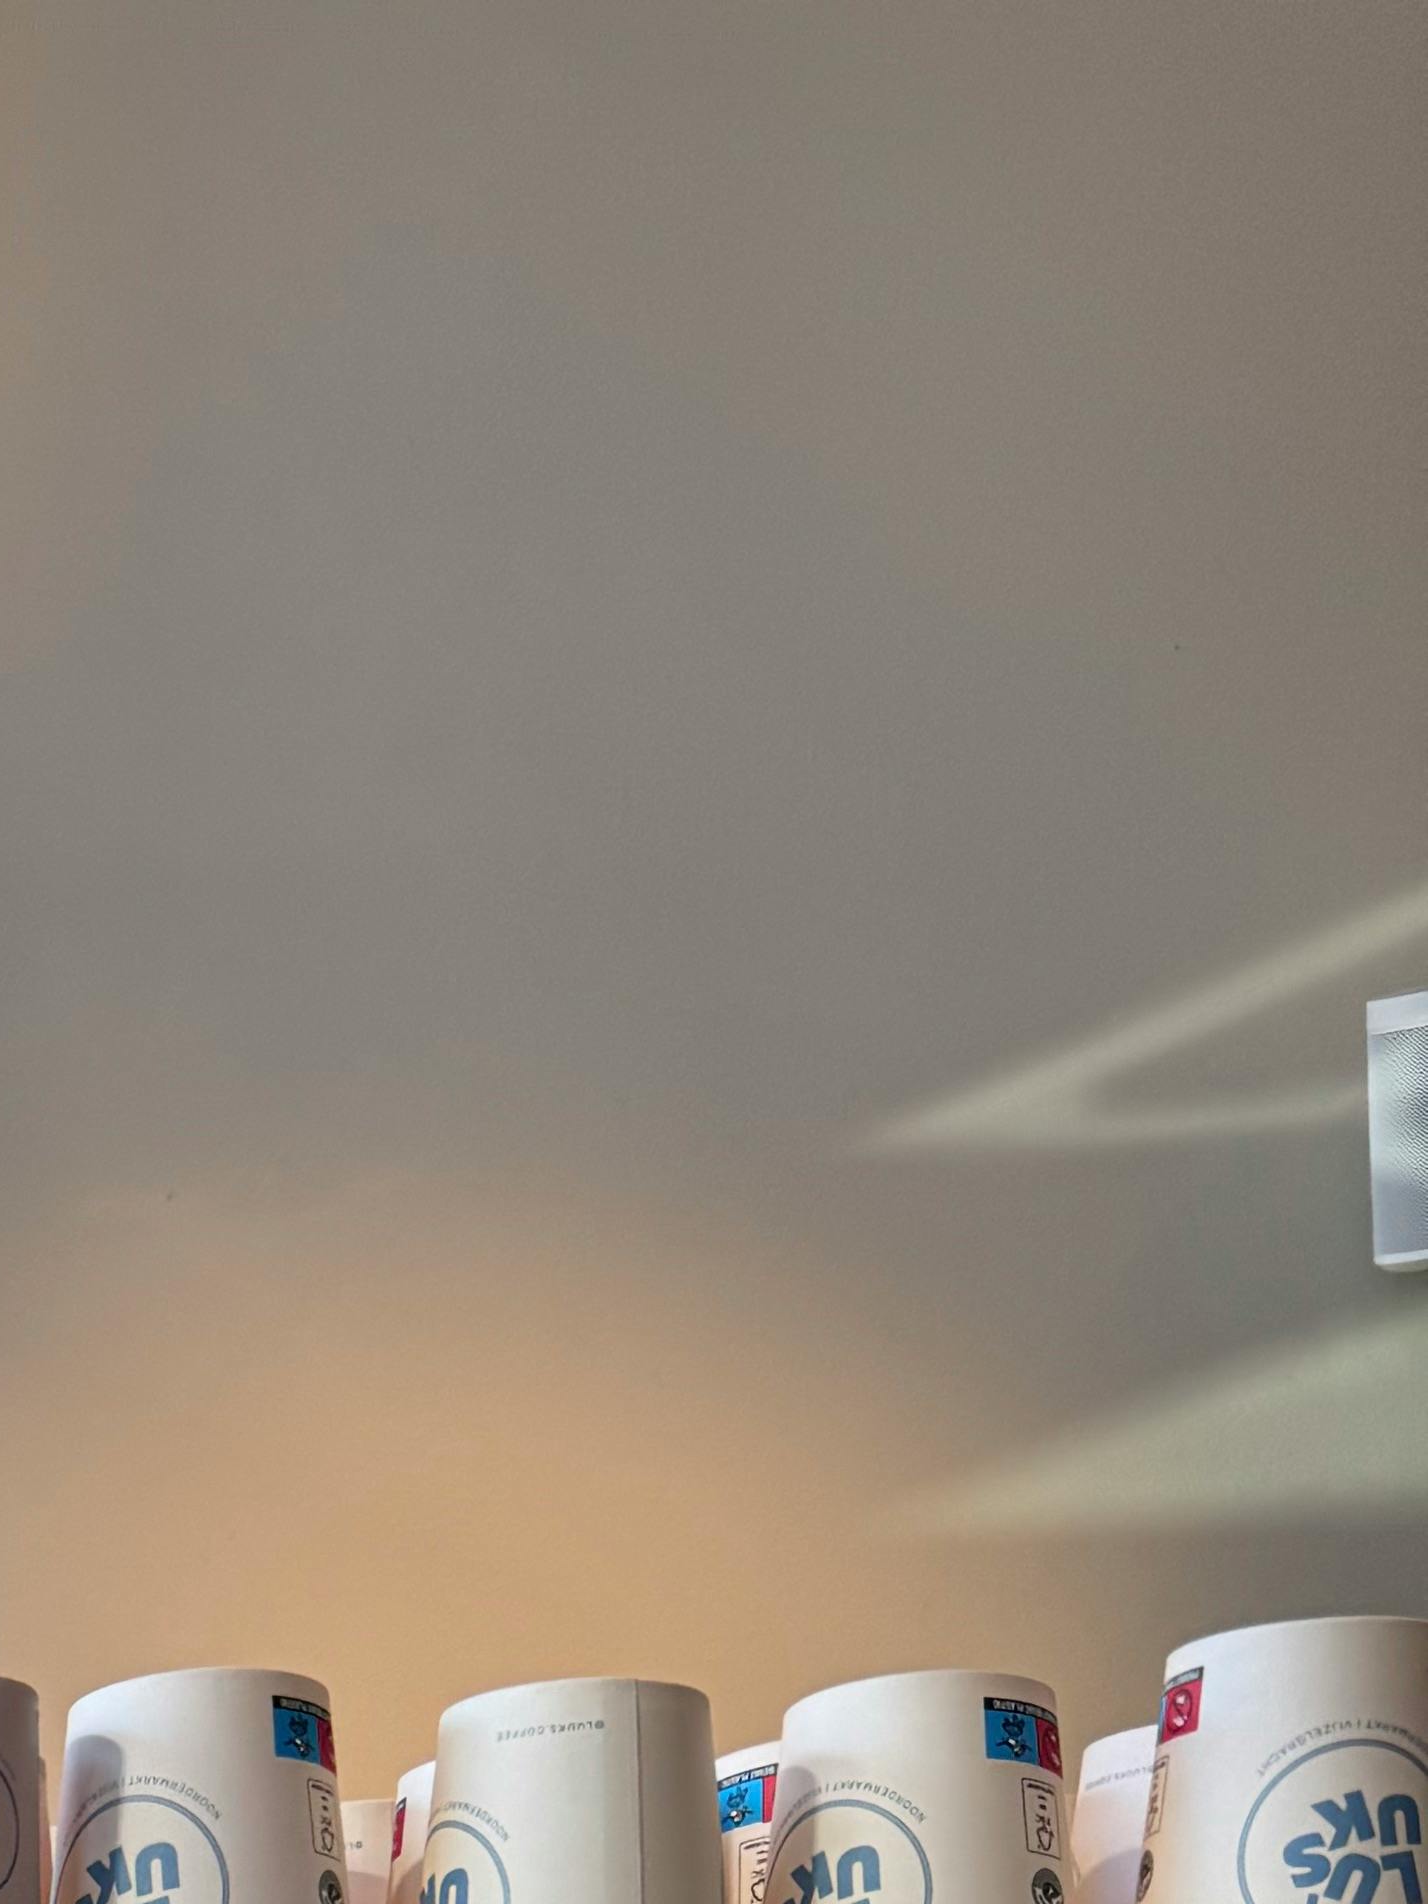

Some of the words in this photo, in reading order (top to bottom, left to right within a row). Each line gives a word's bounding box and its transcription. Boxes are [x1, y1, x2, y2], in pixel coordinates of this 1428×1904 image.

[129, 1775, 223, 1821] NOORDERMARKT
[833, 1779, 927, 1824] NOORDERMARKT
[1310, 1789, 1422, 1851] UK
